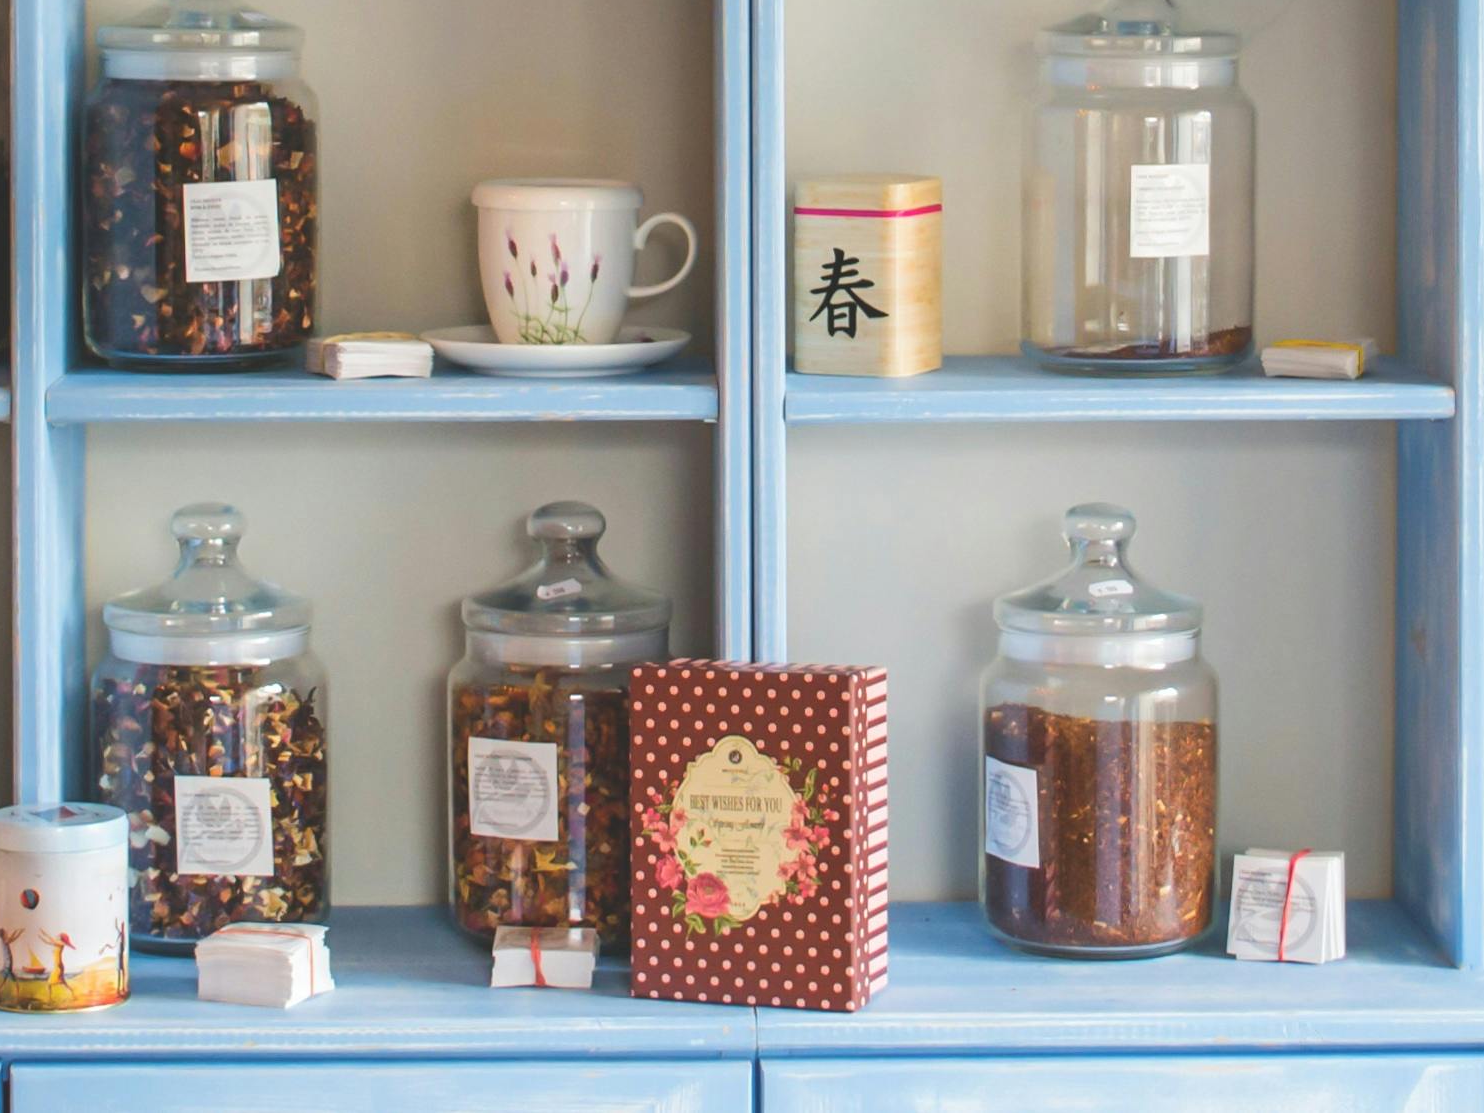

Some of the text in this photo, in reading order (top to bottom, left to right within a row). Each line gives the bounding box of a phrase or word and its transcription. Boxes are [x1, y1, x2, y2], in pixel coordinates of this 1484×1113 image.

[809, 248, 889, 339] 春
[690, 794, 783, 814] BEST WISHES FOR YOU
